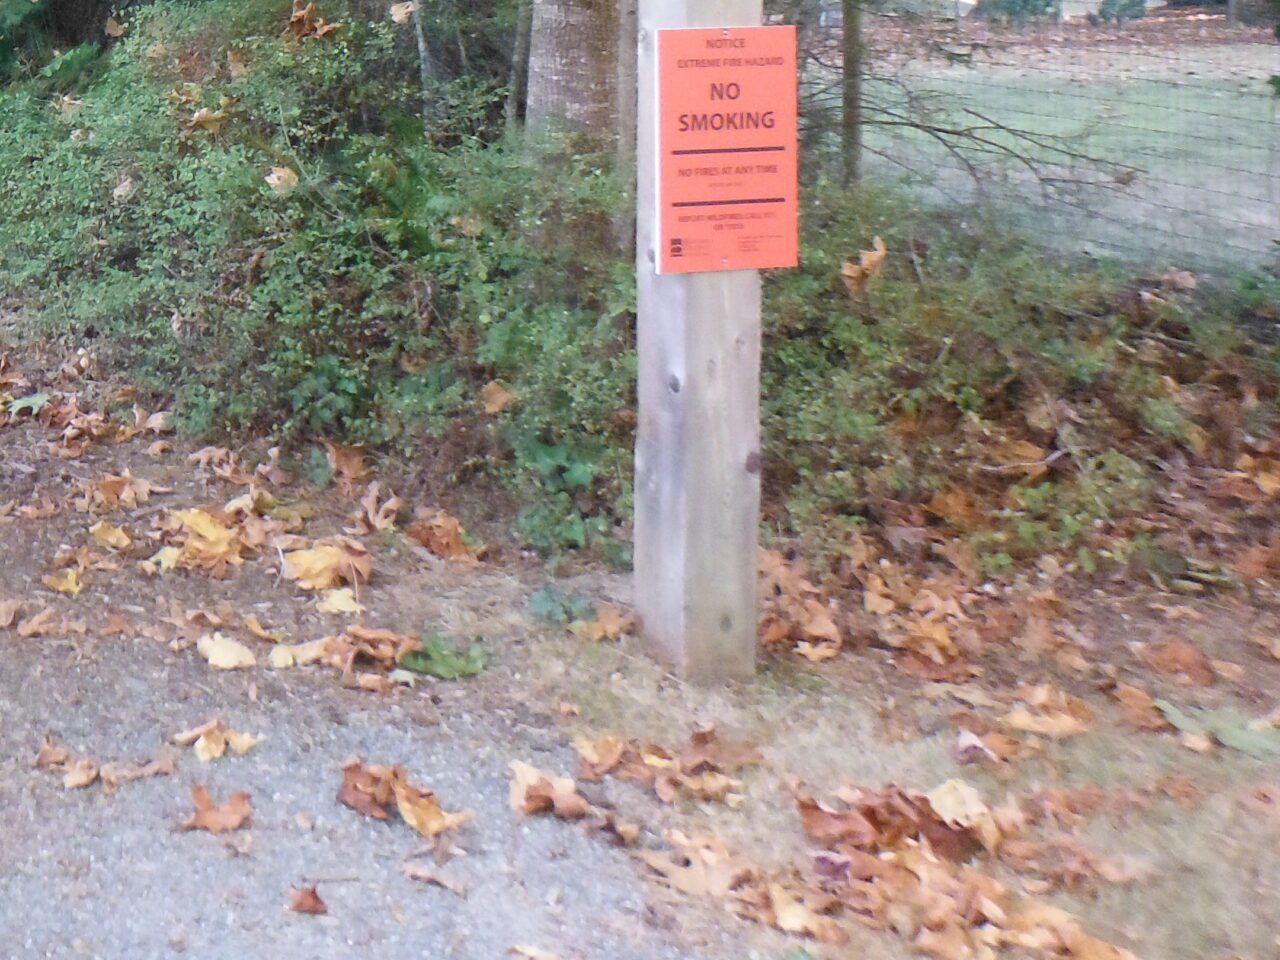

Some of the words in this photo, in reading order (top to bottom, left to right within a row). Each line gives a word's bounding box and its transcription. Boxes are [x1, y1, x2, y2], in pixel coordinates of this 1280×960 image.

[706, 38, 746, 49] NOTICE
[677, 58, 721, 69] EXTREME
[723, 57, 742, 67] FIRE
[744, 56, 785, 67] HAZARD
[710, 82, 741, 101] NO
[678, 111, 776, 132] SMOKING
[678, 168, 692, 177] NO
[694, 167, 719, 176] FIRES
[721, 166, 733, 175] AT
[735, 165, 754, 174] ANY
[755, 164, 778, 174] TIME
